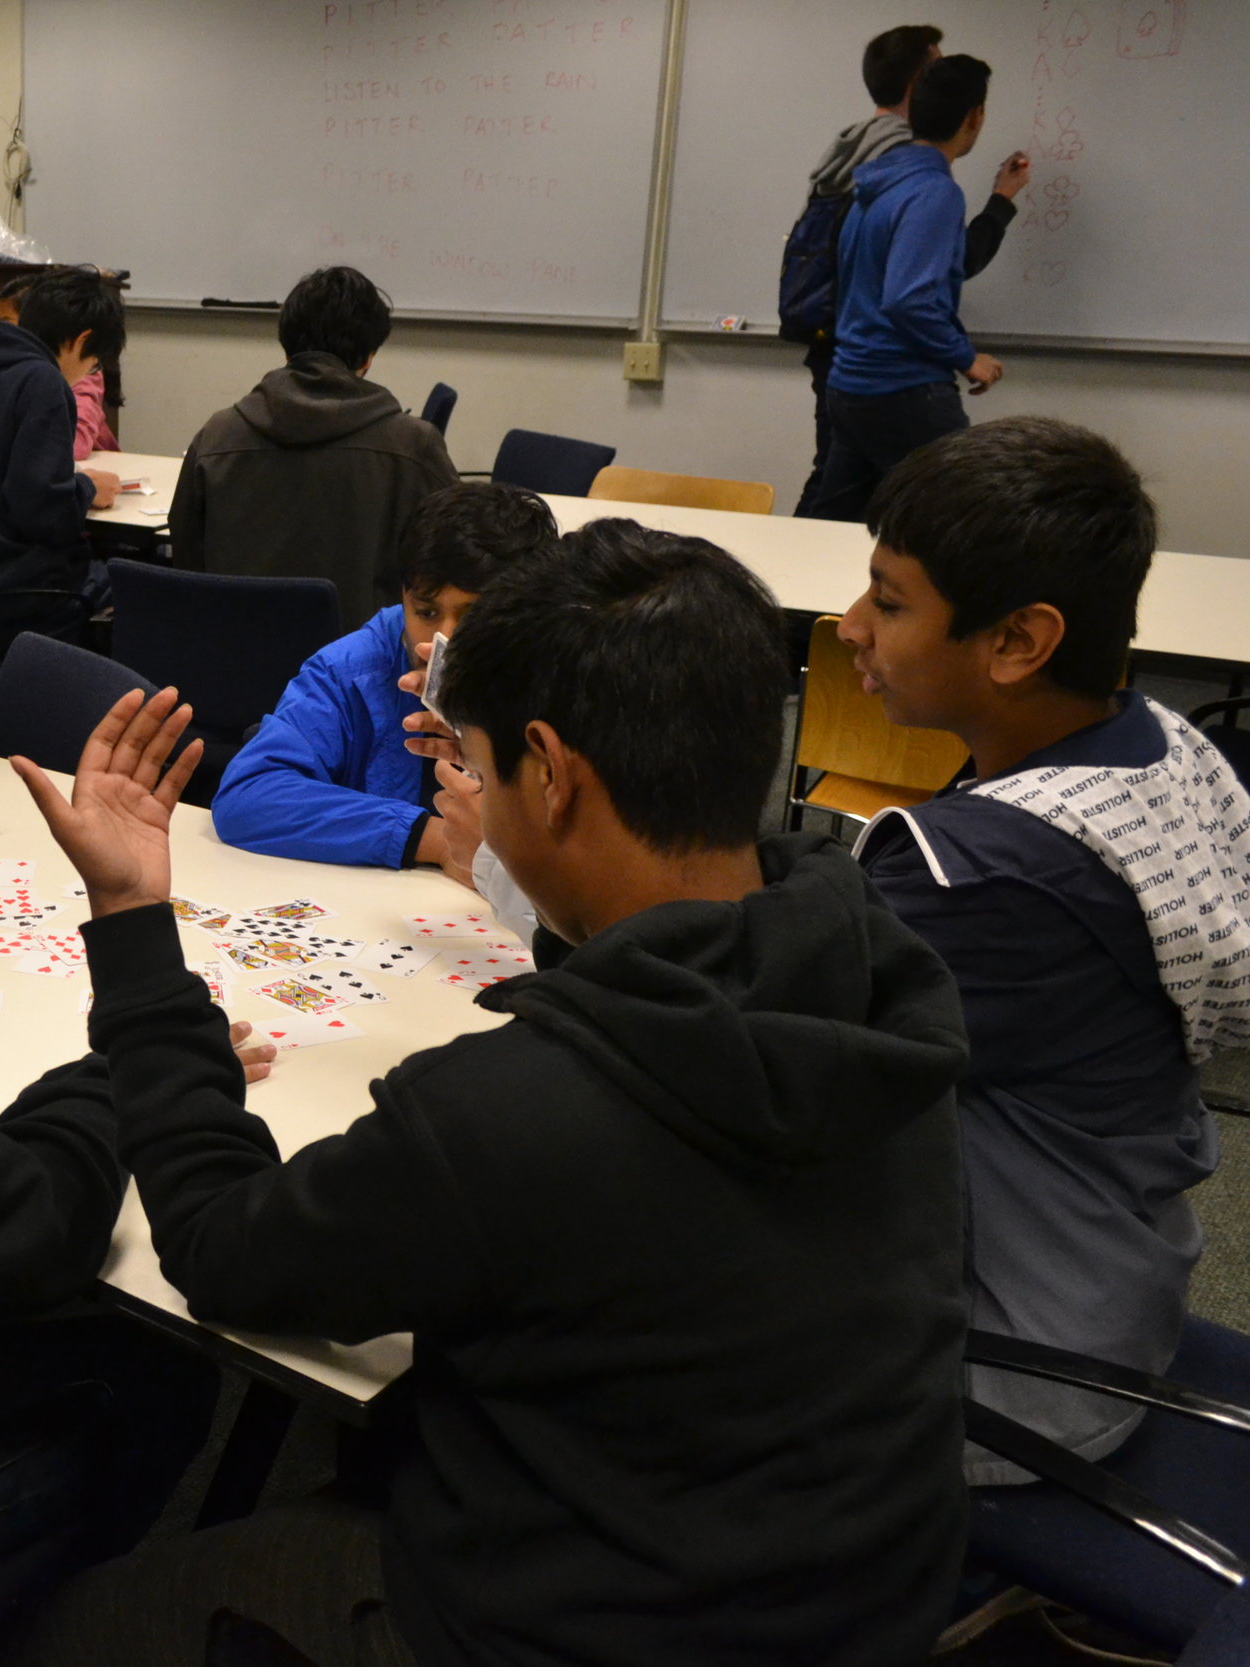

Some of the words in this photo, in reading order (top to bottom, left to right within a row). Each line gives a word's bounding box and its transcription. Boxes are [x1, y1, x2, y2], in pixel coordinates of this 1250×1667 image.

[324, 79, 400, 102] LISTEN
[421, 75, 447, 95] TO
[470, 73, 511, 94] THE
[325, 115, 425, 137] PITTER
[463, 114, 558, 137] PATTER
[1058, 769, 1115, 800] HOLLISTER
